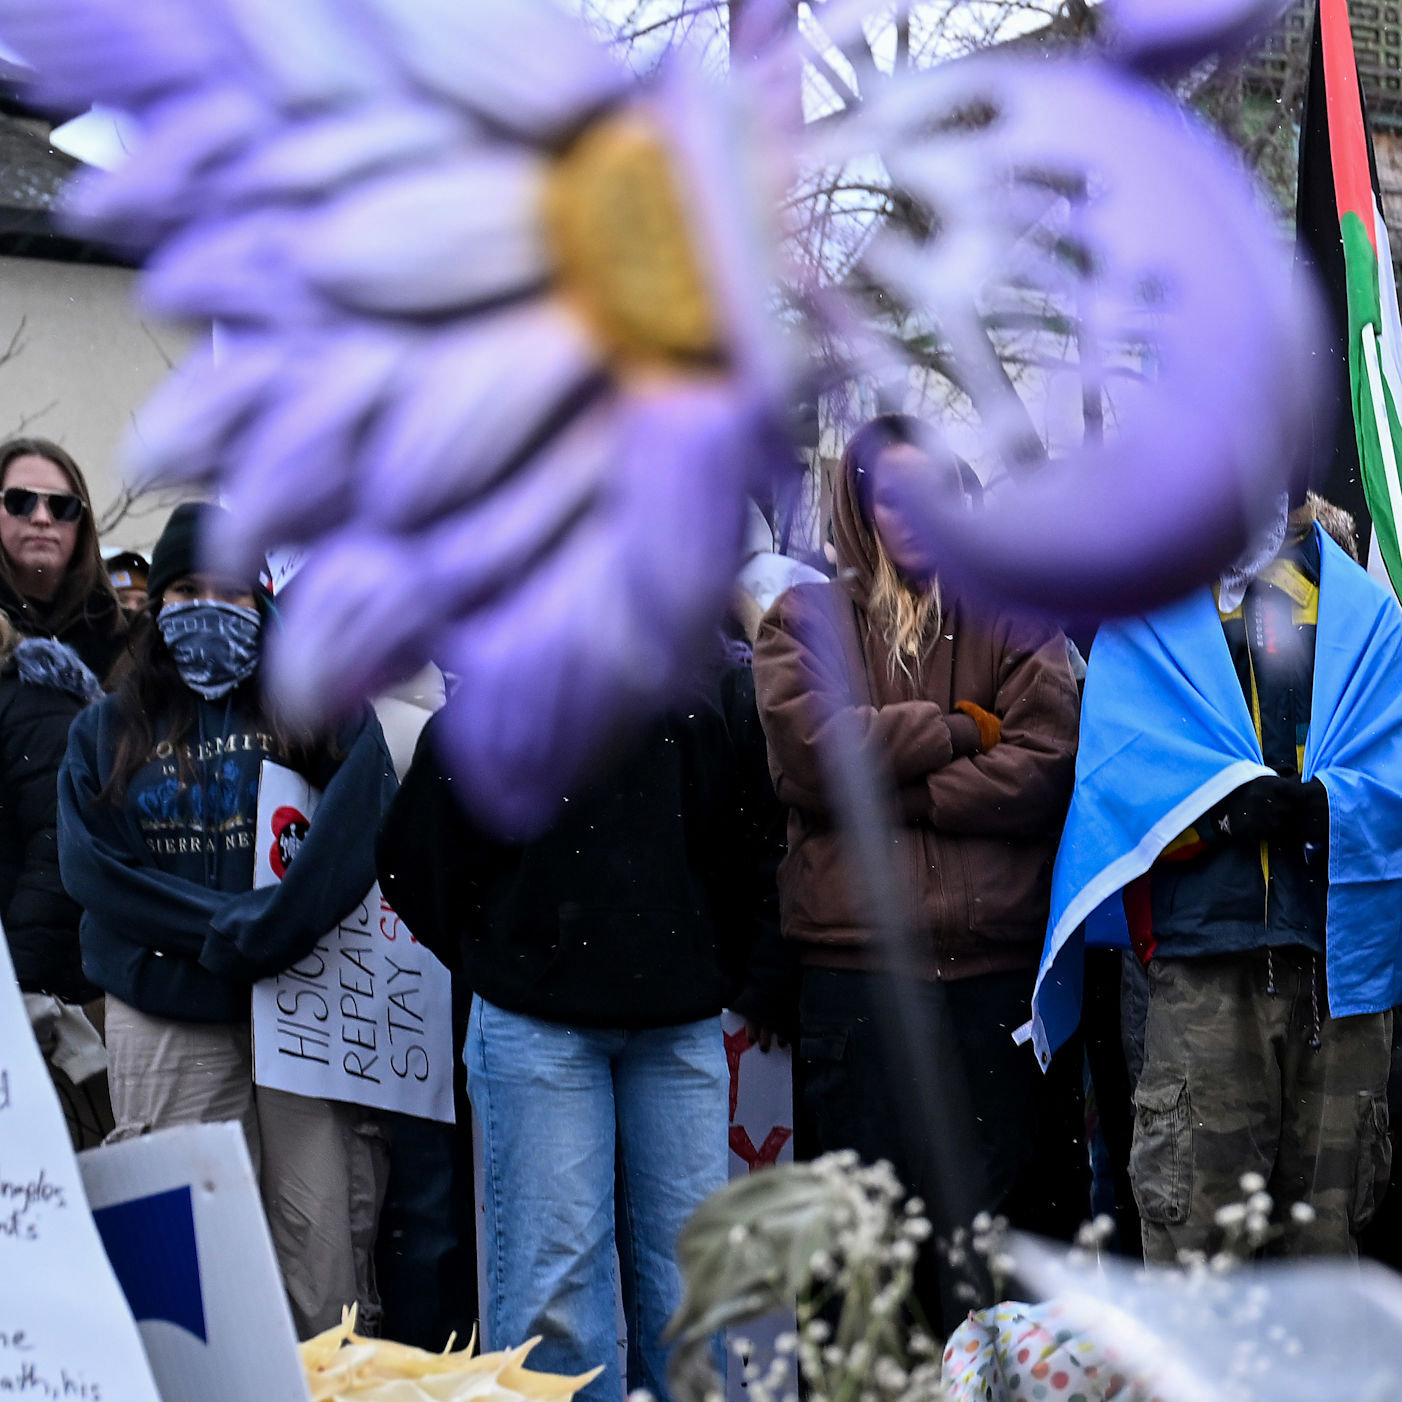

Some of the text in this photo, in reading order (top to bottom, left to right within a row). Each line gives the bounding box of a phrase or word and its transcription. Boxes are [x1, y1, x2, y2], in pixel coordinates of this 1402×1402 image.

[147, 831, 254, 853] SIERRA NE
[276, 947, 330, 1065] HISTO
[385, 956, 429, 1081] STAY
